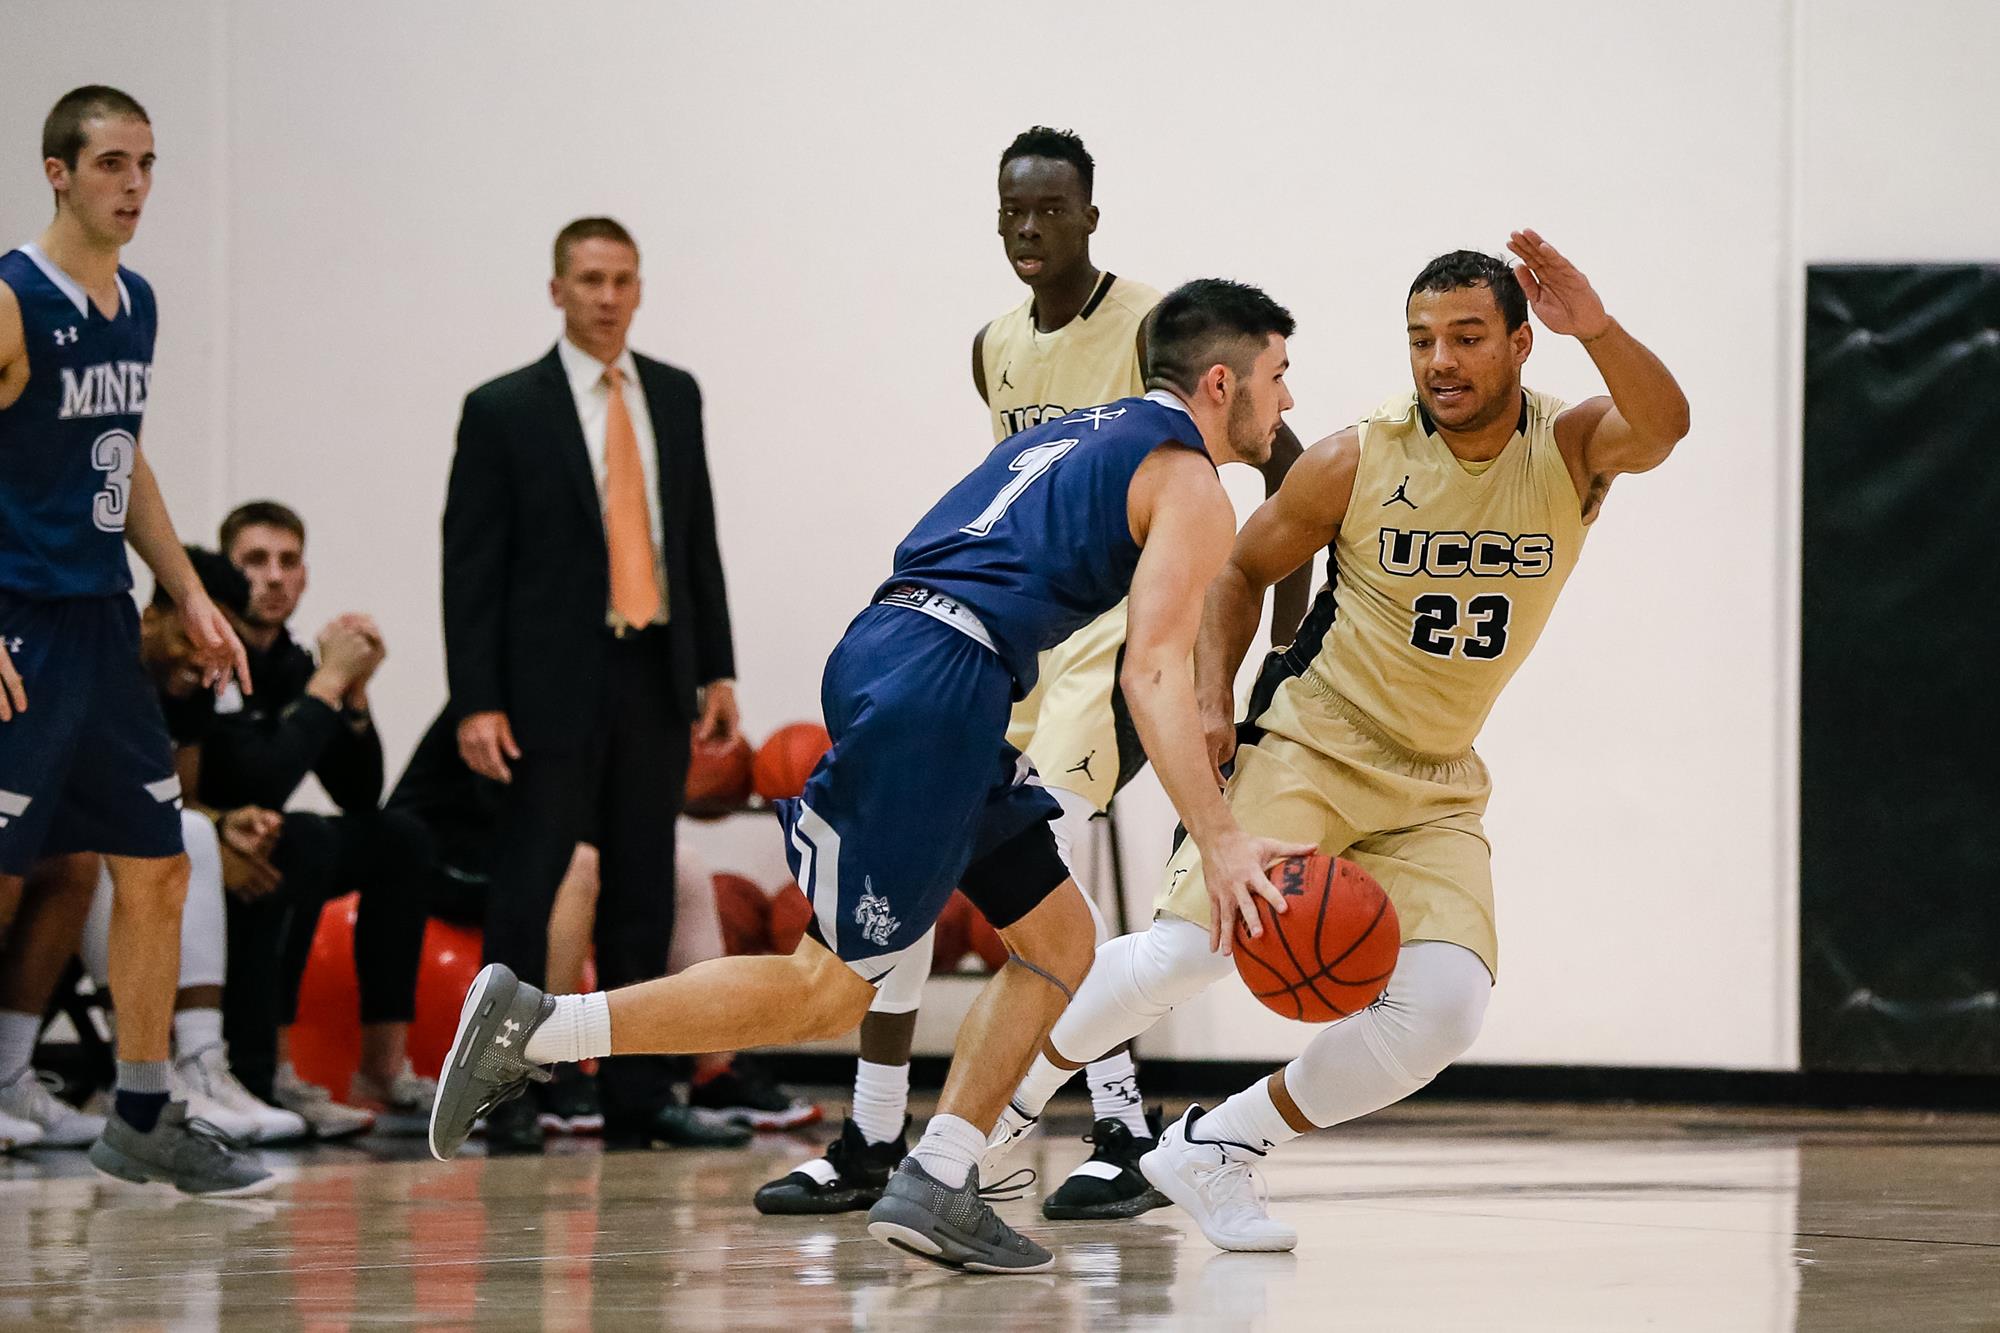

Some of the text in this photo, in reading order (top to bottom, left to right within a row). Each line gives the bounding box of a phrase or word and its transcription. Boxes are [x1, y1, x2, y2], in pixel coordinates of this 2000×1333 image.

[92, 429, 137, 532] 3
[959, 438, 1080, 537] 1
[1379, 527, 1554, 578] UCCS
[1409, 592, 1512, 661] 23
